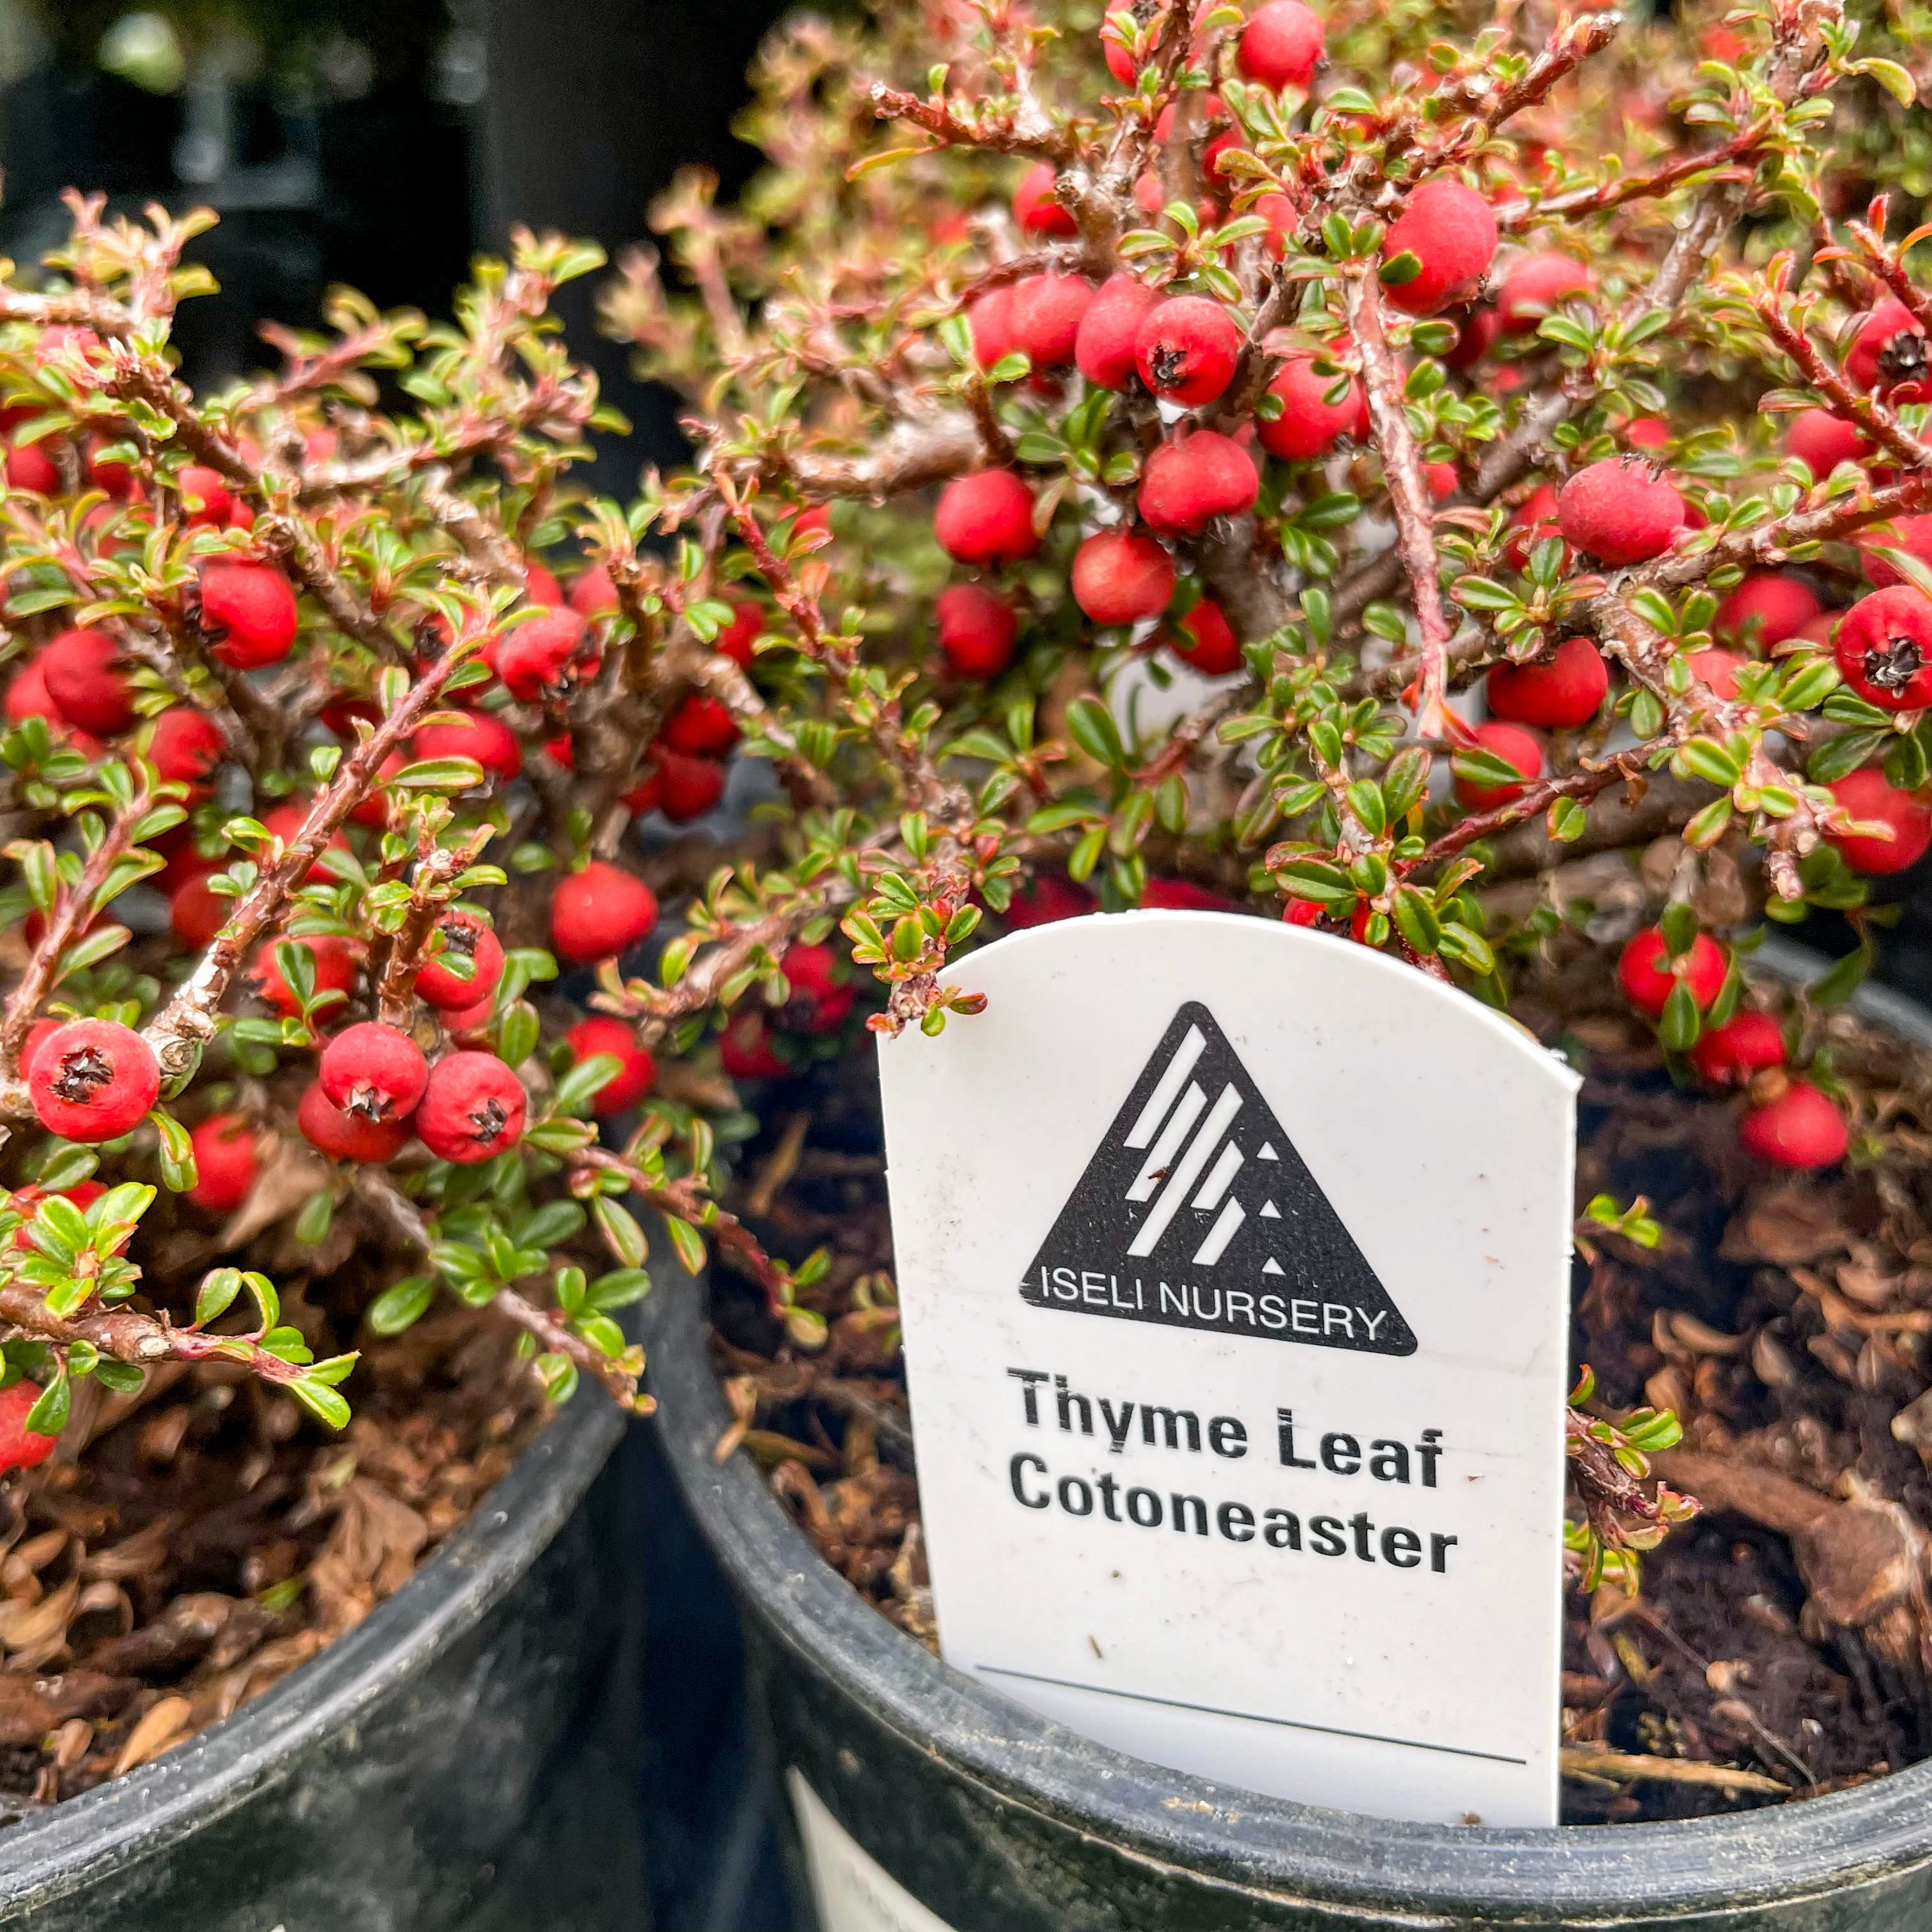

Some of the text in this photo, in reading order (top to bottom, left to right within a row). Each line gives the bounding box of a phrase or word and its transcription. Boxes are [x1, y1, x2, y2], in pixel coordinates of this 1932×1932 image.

[1041, 1265, 1387, 1341] ISELI NURSERY
[1007, 1367, 1444, 1487] Thyme Leaf
[1009, 1452, 1458, 1574] Cotoneaster
